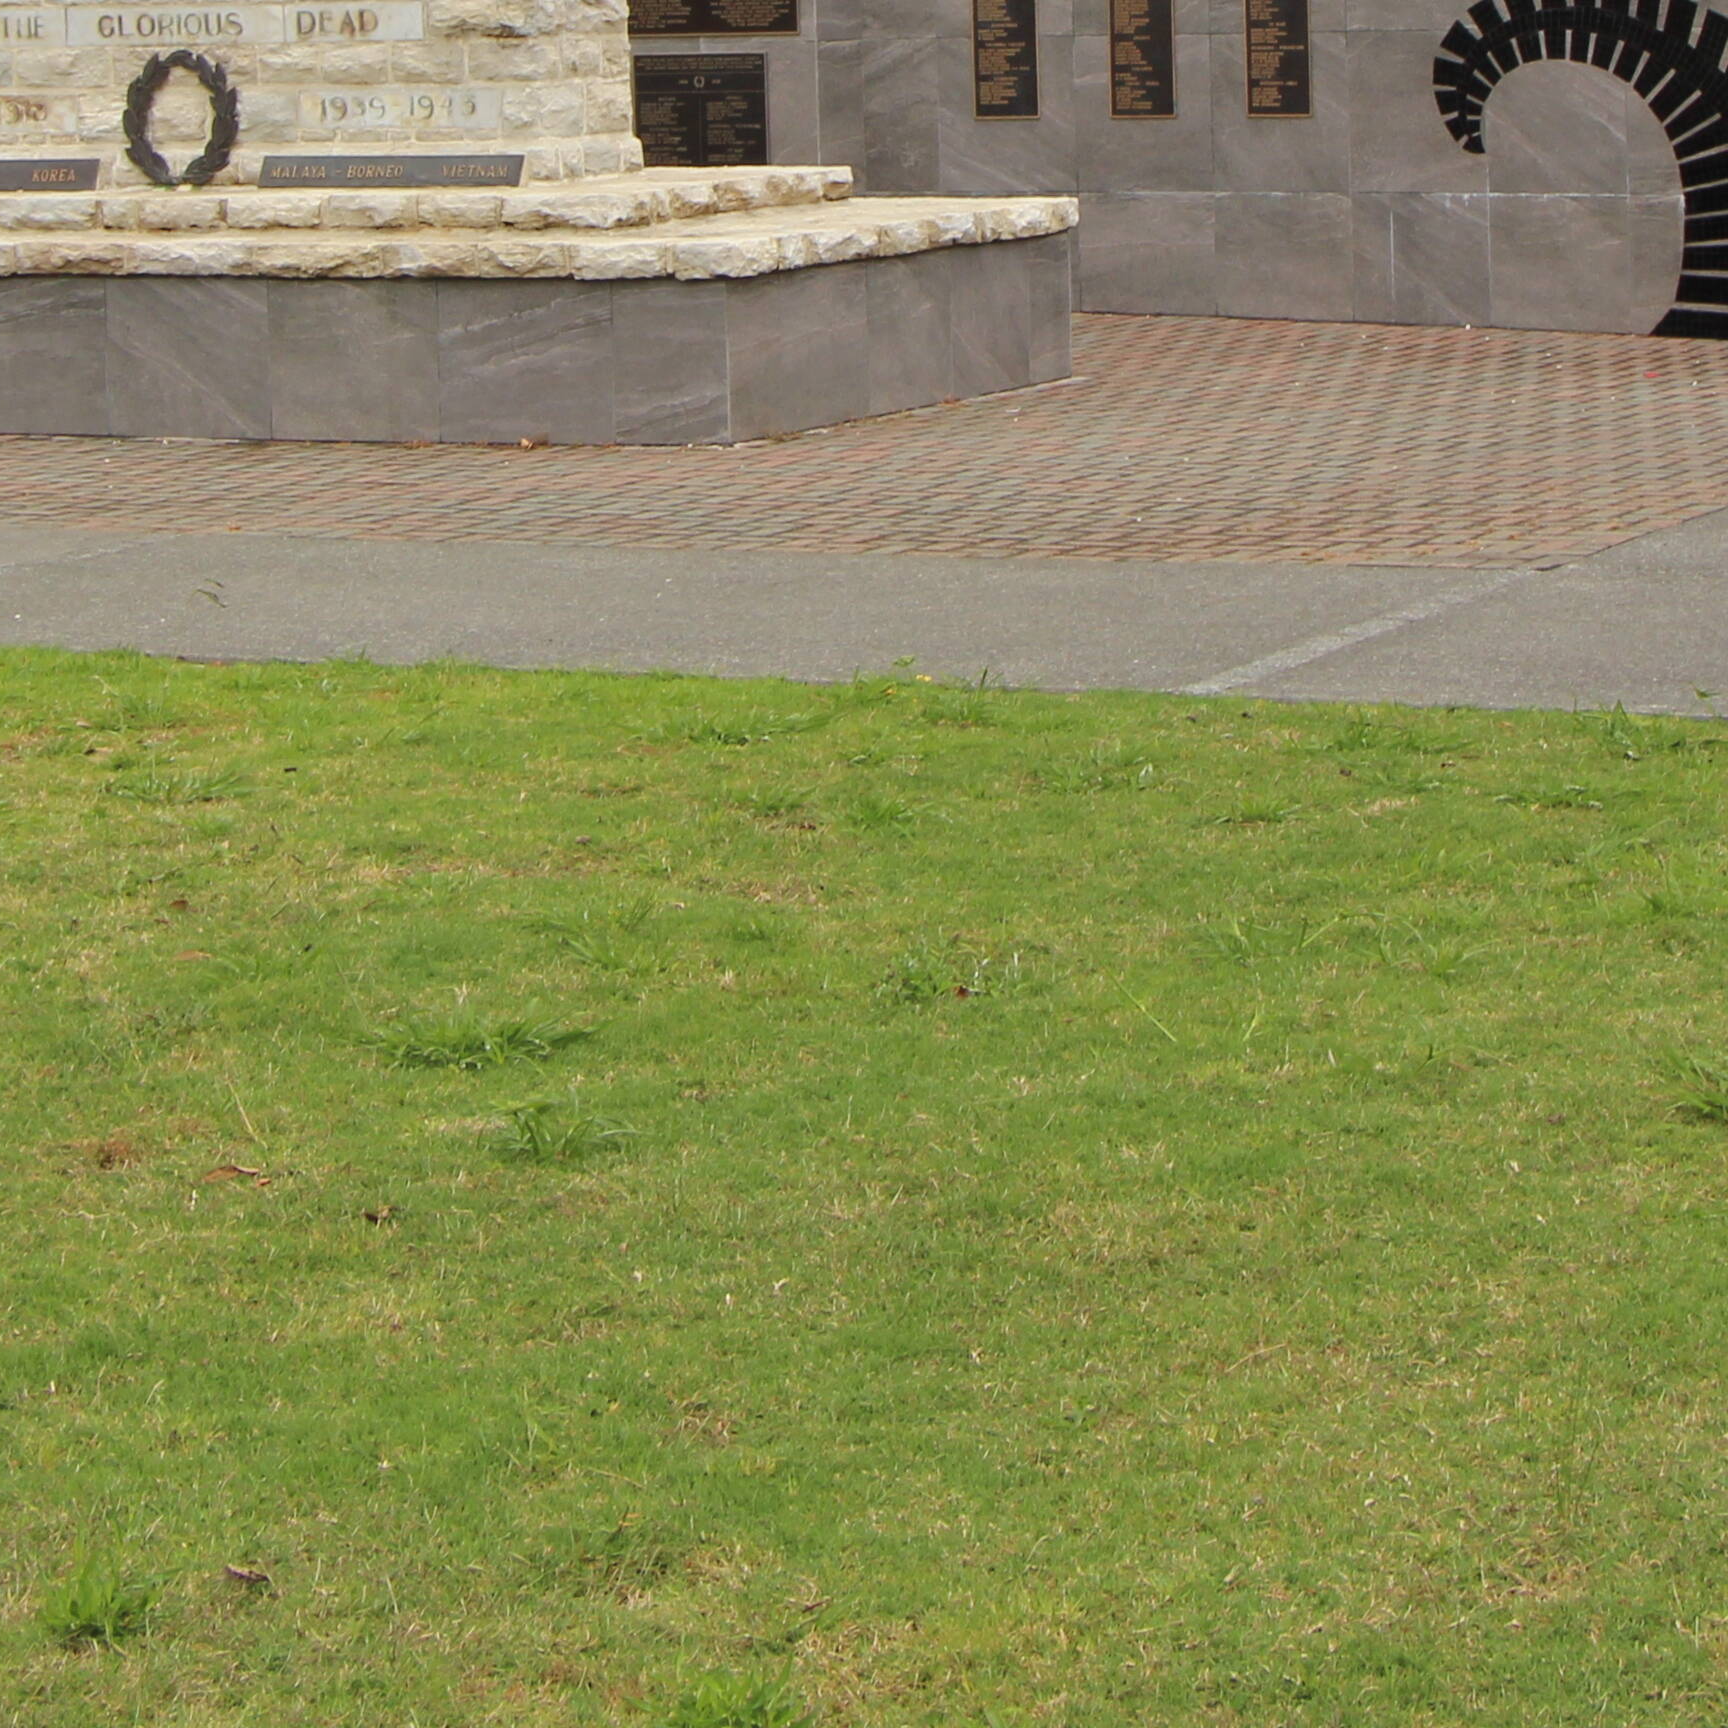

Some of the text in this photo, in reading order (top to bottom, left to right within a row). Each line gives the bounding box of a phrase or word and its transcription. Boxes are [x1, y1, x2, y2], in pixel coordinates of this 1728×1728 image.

[1, 8, 380, 40] THE GLORIOUS DEAD
[31, 168, 76, 183] KOREA
[271, 165, 326, 179] MALAYA
[346, 164, 404, 179] BORNEO
[441, 164, 509, 179] VIETNAM
